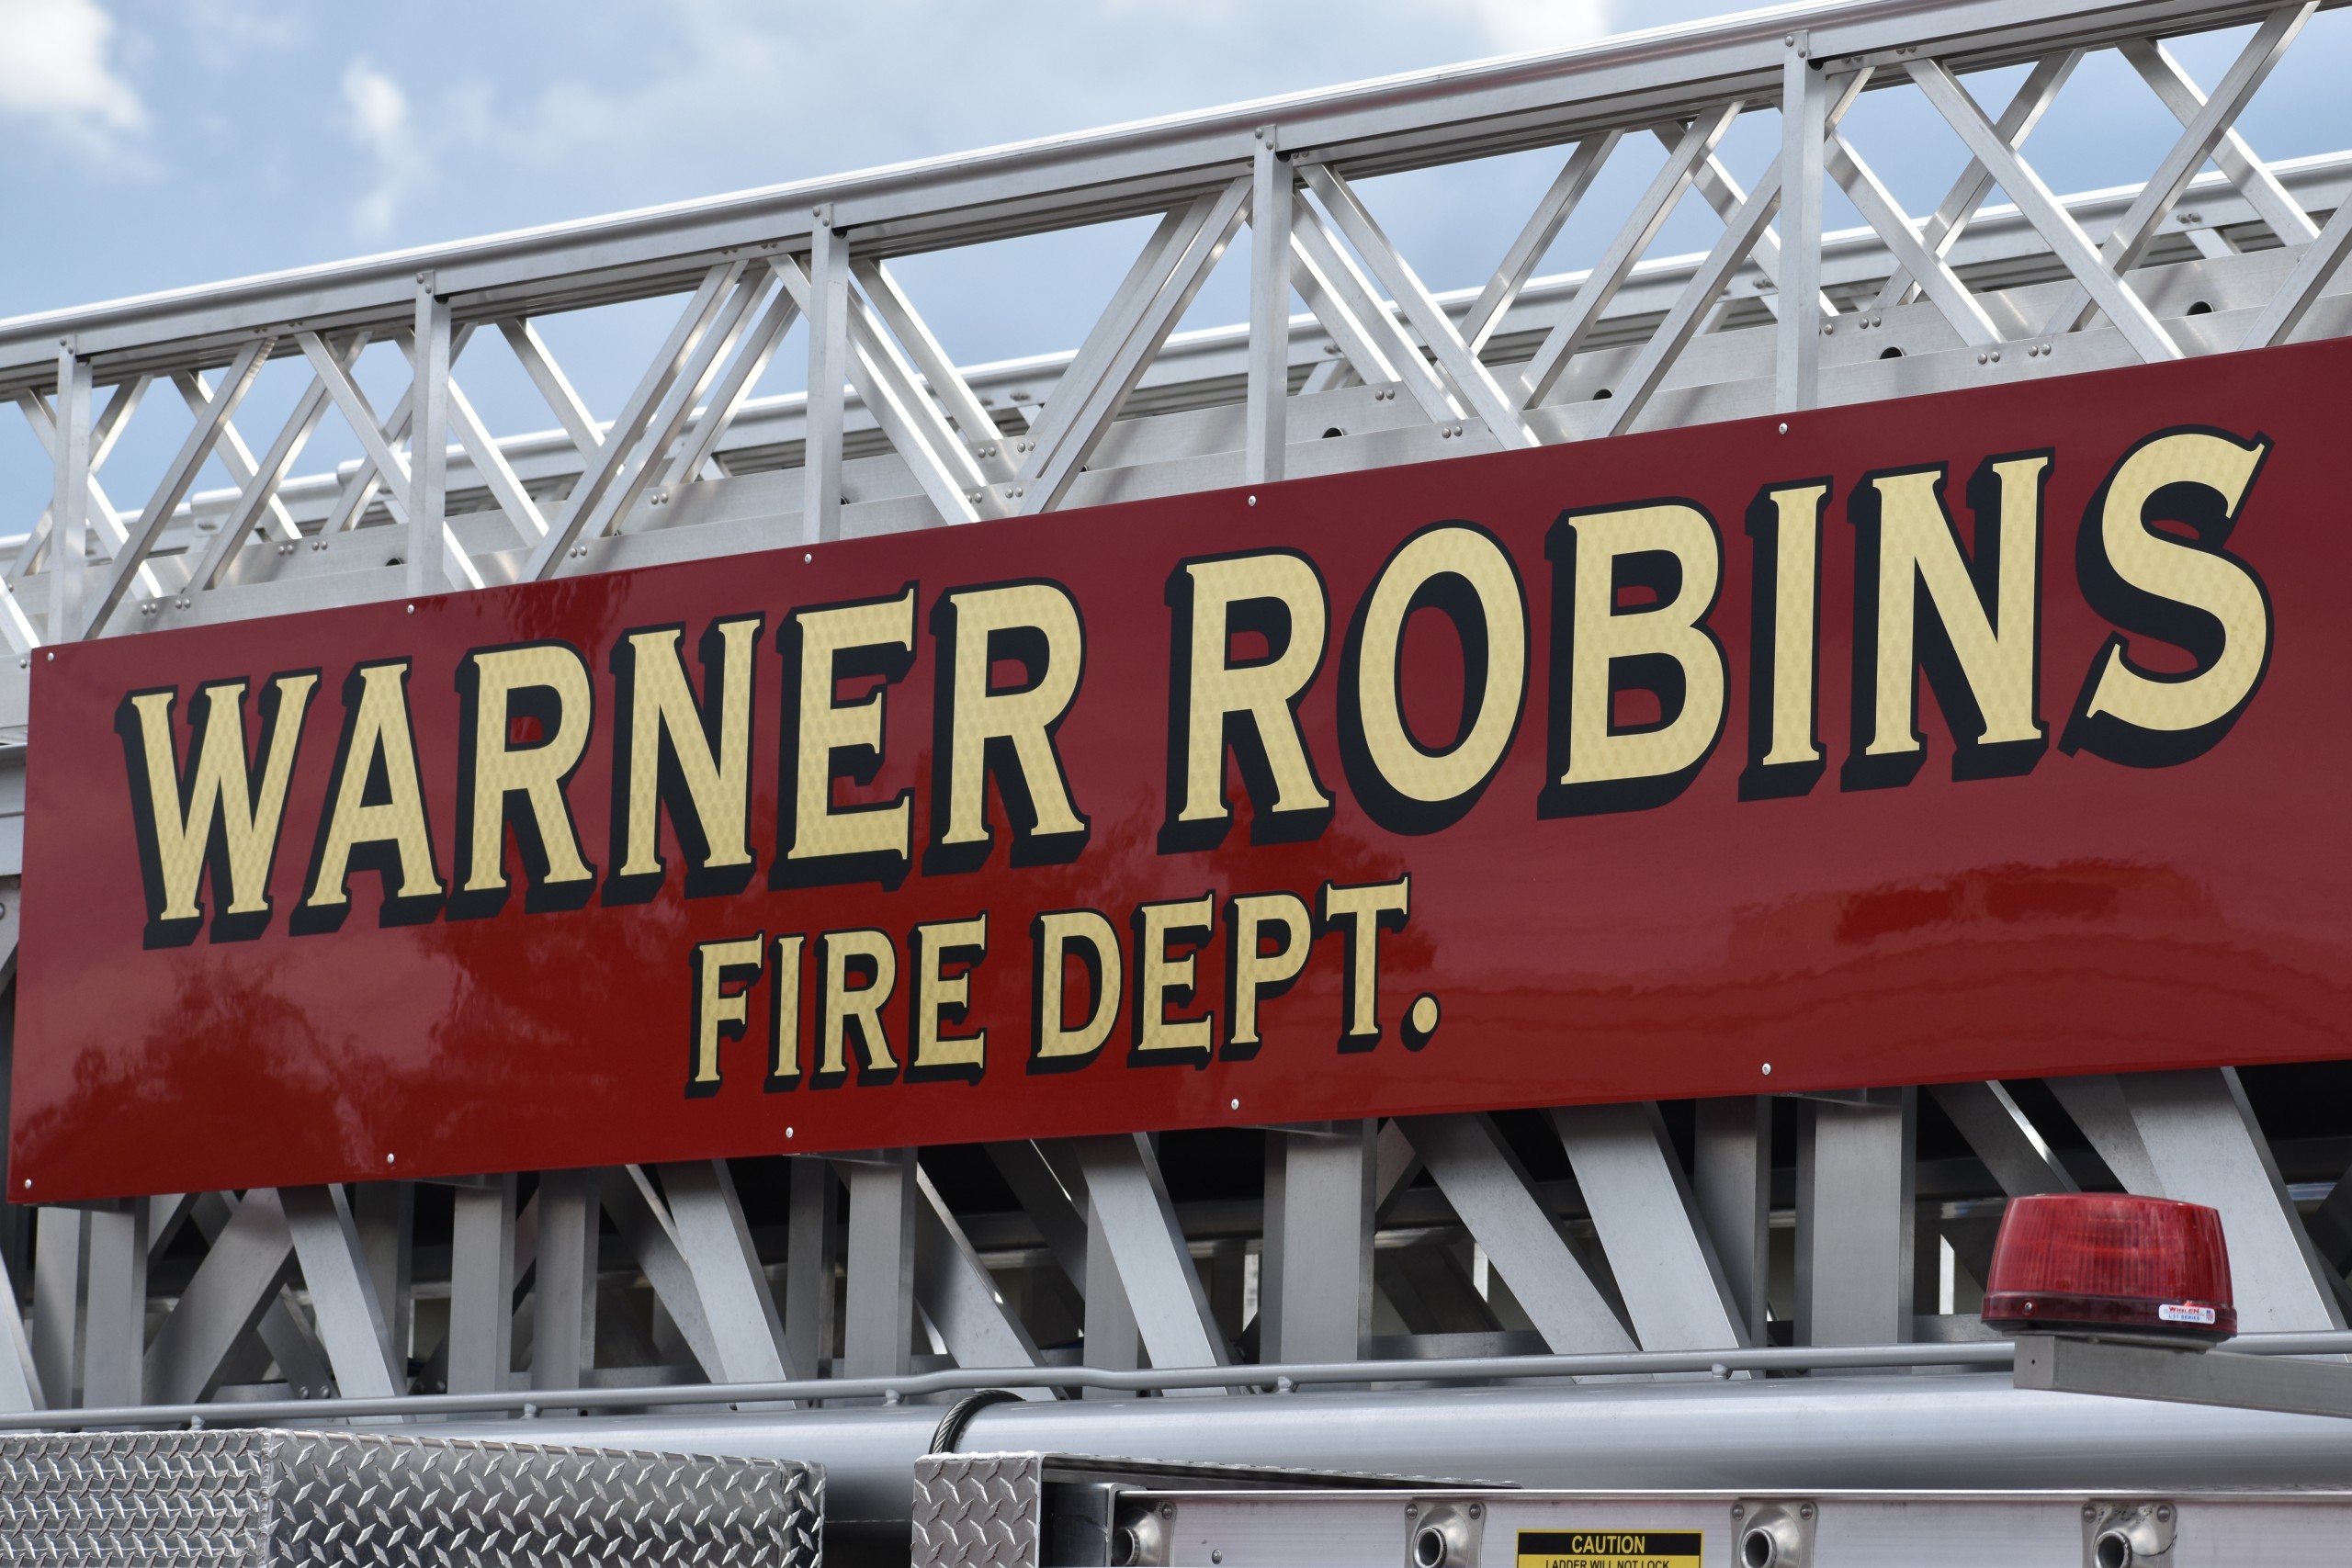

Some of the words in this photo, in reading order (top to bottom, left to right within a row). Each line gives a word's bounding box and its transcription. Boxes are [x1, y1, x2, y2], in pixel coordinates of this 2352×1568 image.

[127, 580, 1088, 926] WARNER
[1175, 430, 2270, 826] ROBINS
[691, 911, 989, 1088] FIRE
[1033, 874, 1440, 1062] DEPT.
[2168, 1305, 2199, 1314] WHELEN
[1571, 1535, 1645, 1554] CAUTION
[1545, 1560, 1587, 1568] LADDER
[1617, 1560, 1638, 1568] NOT
